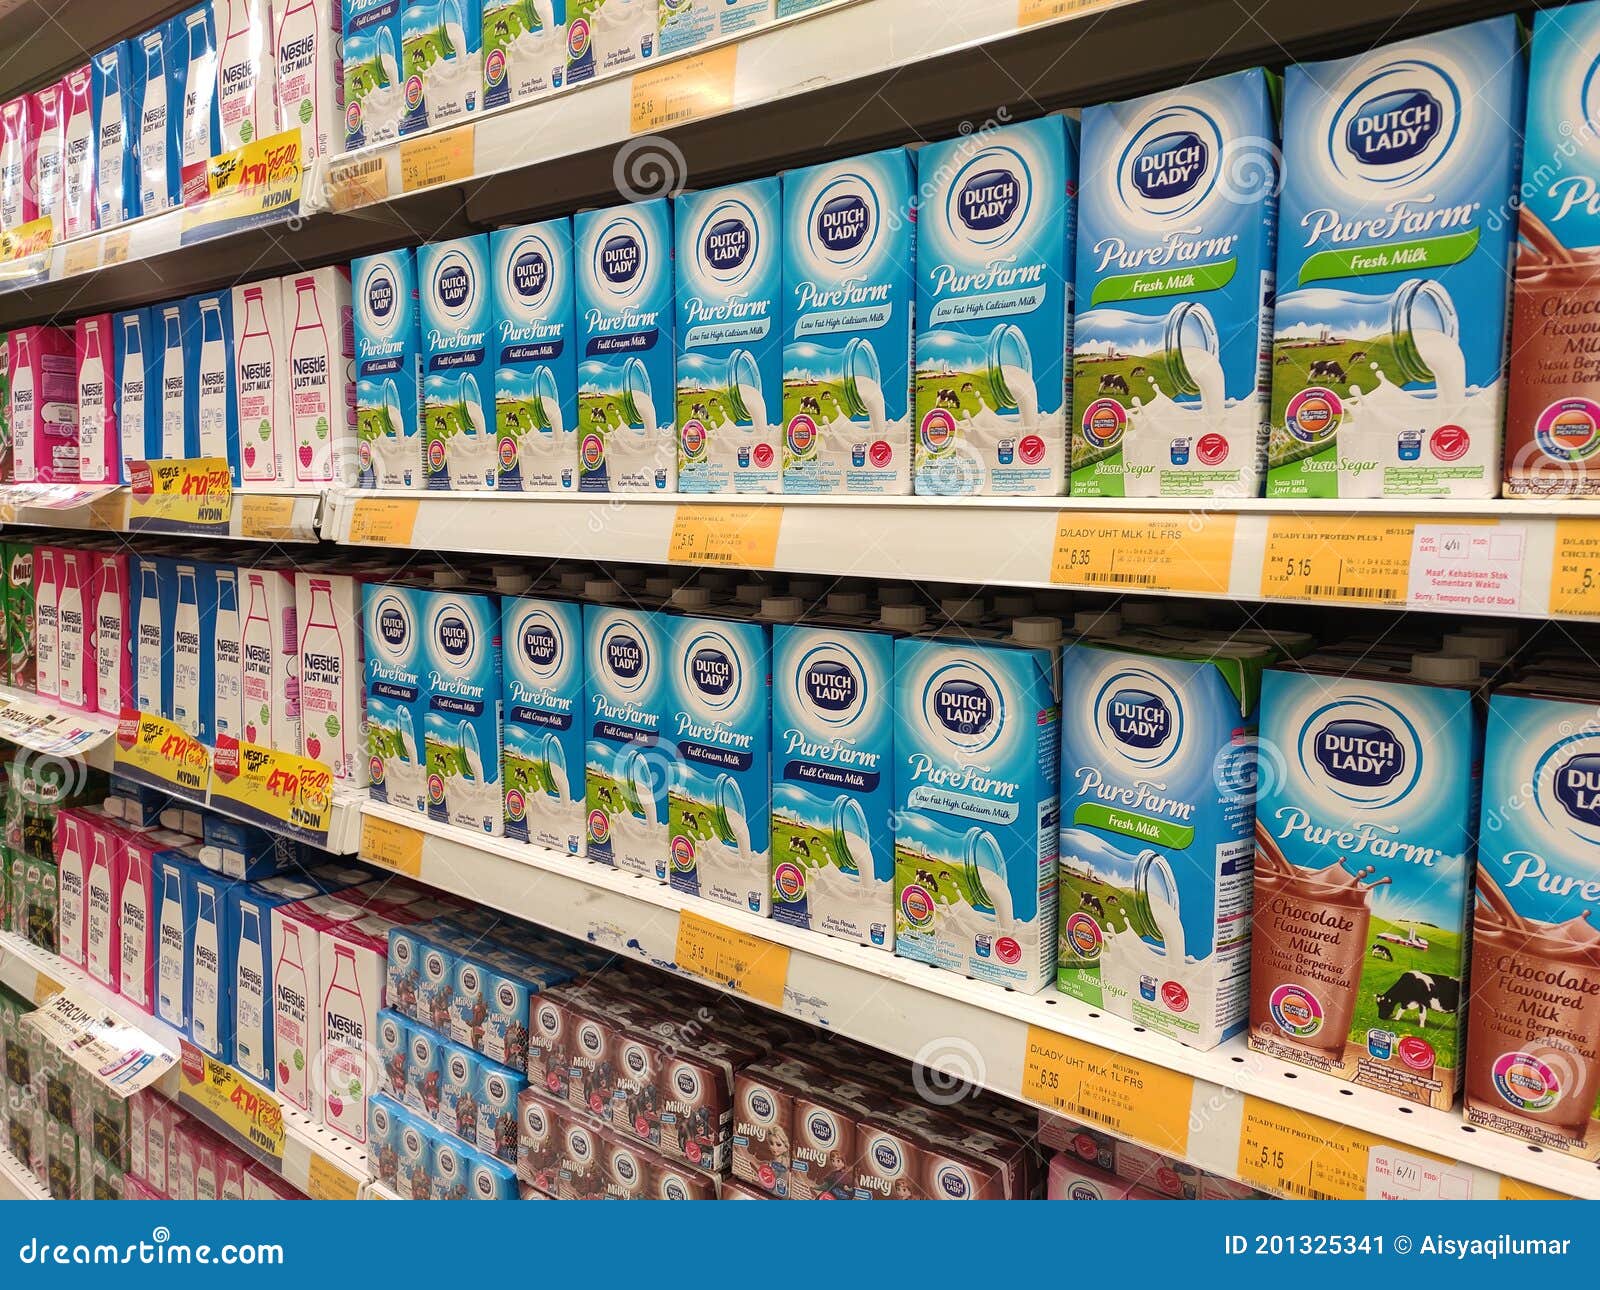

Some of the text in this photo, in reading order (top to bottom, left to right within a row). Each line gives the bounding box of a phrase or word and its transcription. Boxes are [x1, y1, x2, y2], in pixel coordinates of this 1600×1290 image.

[1357, 104, 1431, 135] DUTCH
[1365, 125, 1430, 154] LADY
[1141, 145, 1200, 173] DUTCH
[1147, 165, 1198, 189] LADY
[262, 189, 291, 208] MYDIN
[965, 184, 1014, 206] DUTCH
[823, 208, 864, 227] DUTCH
[970, 200, 1013, 220] LADY
[1301, 194, 1481, 247] PureFarm
[710, 232, 746, 250] DUTCH
[829, 224, 863, 241] LADY
[605, 247, 637, 262] DUTCH
[714, 244, 745, 261] LADY
[1094, 226, 1238, 273] PureFarm
[1350, 246, 1428, 270] Fresh Milk
[516, 262, 544, 277] DUTCH
[609, 259, 636, 274] LADY
[930, 255, 1046, 296] PureFarm
[441, 275, 466, 289] DUTCH
[520, 274, 544, 288] LADY
[1133, 274, 1196, 294] Fresh Milk
[371, 287, 391, 299] DUTCH
[444, 286, 466, 299] LADY
[795, 274, 892, 310] PureFarm
[373, 297, 391, 310] LADY
[685, 293, 770, 323] PureFarm
[938, 296, 1036, 316] Low Fat High Calcium Milk
[585, 305, 658, 333] PureFarm
[427, 327, 485, 351] PureFarm
[499, 317, 564, 342] PureFarm
[360, 334, 404, 357] PureFarm
[597, 336, 646, 349] Full Cream Milk
[1564, 338, 1600, 354] Mil
[294, 355, 326, 375] Nestlé
[242, 380, 272, 393] JUST MILK
[294, 375, 327, 389] JUST MILK
[1095, 461, 1155, 478] Susu Segar
[1301, 457, 1378, 476] Susu Segar
[1060, 529, 1095, 537] D/LADY
[1098, 530, 1119, 538] UHT
[1122, 530, 1142, 538] MLK
[1160, 531, 1182, 539] FRS
[1071, 550, 1090, 565] 6.35
[1286, 558, 1311, 576] 5.15
[1426, 569, 1448, 577] Maaf,
[1449, 569, 1488, 578] Kehabisan
[1432, 579, 1500, 589] Sementara Waktu
[1436, 594, 1471, 605] Temporary
[1498, 597, 1515, 605] Stock
[383, 616, 403, 629] DUTCH
[385, 627, 403, 638] LADY
[442, 627, 466, 640] DUTCH
[445, 636, 466, 648] LADY
[527, 634, 553, 648] DUTCH
[531, 645, 553, 658] LADY
[611, 645, 639, 659] DUTCH
[370, 659, 419, 685] PureFarm
[614, 657, 638, 670] LADY
[695, 658, 729, 676] DUTCH
[305, 671, 340, 685] JUST MILK
[428, 670, 483, 698] PureFarm
[700, 672, 728, 687] LADY
[811, 673, 851, 689] DUTCH
[510, 680, 572, 711] PureFarm
[816, 686, 850, 701] LADY
[941, 692, 987, 712] DUTCH
[593, 694, 659, 727] PureFarm
[946, 708, 986, 725] LADY
[1113, 701, 1164, 725] DUTCH
[674, 712, 753, 747] PureFarm
[1119, 718, 1163, 738] LADY
[687, 746, 740, 765] Full Cream Milk
[784, 729, 880, 768] PureFarm
[1324, 733, 1394, 759] DUTCH
[1332, 754, 1393, 775] LADY
[176, 770, 200, 787] MYDIN
[799, 765, 864, 787] Full Cream Milk
[908, 754, 1020, 798] PureFarm
[1075, 766, 1196, 821] PureFarm
[916, 792, 1010, 819] Low Fat High Calcium Milk
[291, 808, 320, 828] MYDIN
[1108, 814, 1160, 839] Fresh Milk
[1275, 806, 1442, 867] PureFarm
[1271, 898, 1353, 931] Chocolate
[1273, 917, 1341, 945] Flavoured
[1289, 935, 1322, 956] Milk
[1295, 952, 1344, 976] Berperisa
[1294, 964, 1351, 988] Berkhasiat
[1497, 955, 1600, 995] Chocolate
[1499, 976, 1584, 1010] Flavoured
[1517, 999, 1560, 1023] Milk
[327, 1028, 363, 1051] JUST MILK
[1526, 1019, 1588, 1043] Berperisa
[1030, 1044, 1143, 1089] D/LADY UHT MLK FRS
[1040, 1069, 1059, 1089] 6.35
[249, 1126, 276, 1152] MYDIN
[738, 1122, 766, 1142] Milky
[1248, 1115, 1345, 1151] D/LADY UHT PROTEIN PLUS
[797, 1146, 828, 1168] Milky
[1260, 1146, 1284, 1169] 5.15
[1375, 1166, 1393, 1176] DATE:
[1396, 1167, 1416, 1180] 6/11
[859, 1174, 892, 1196] Milky
